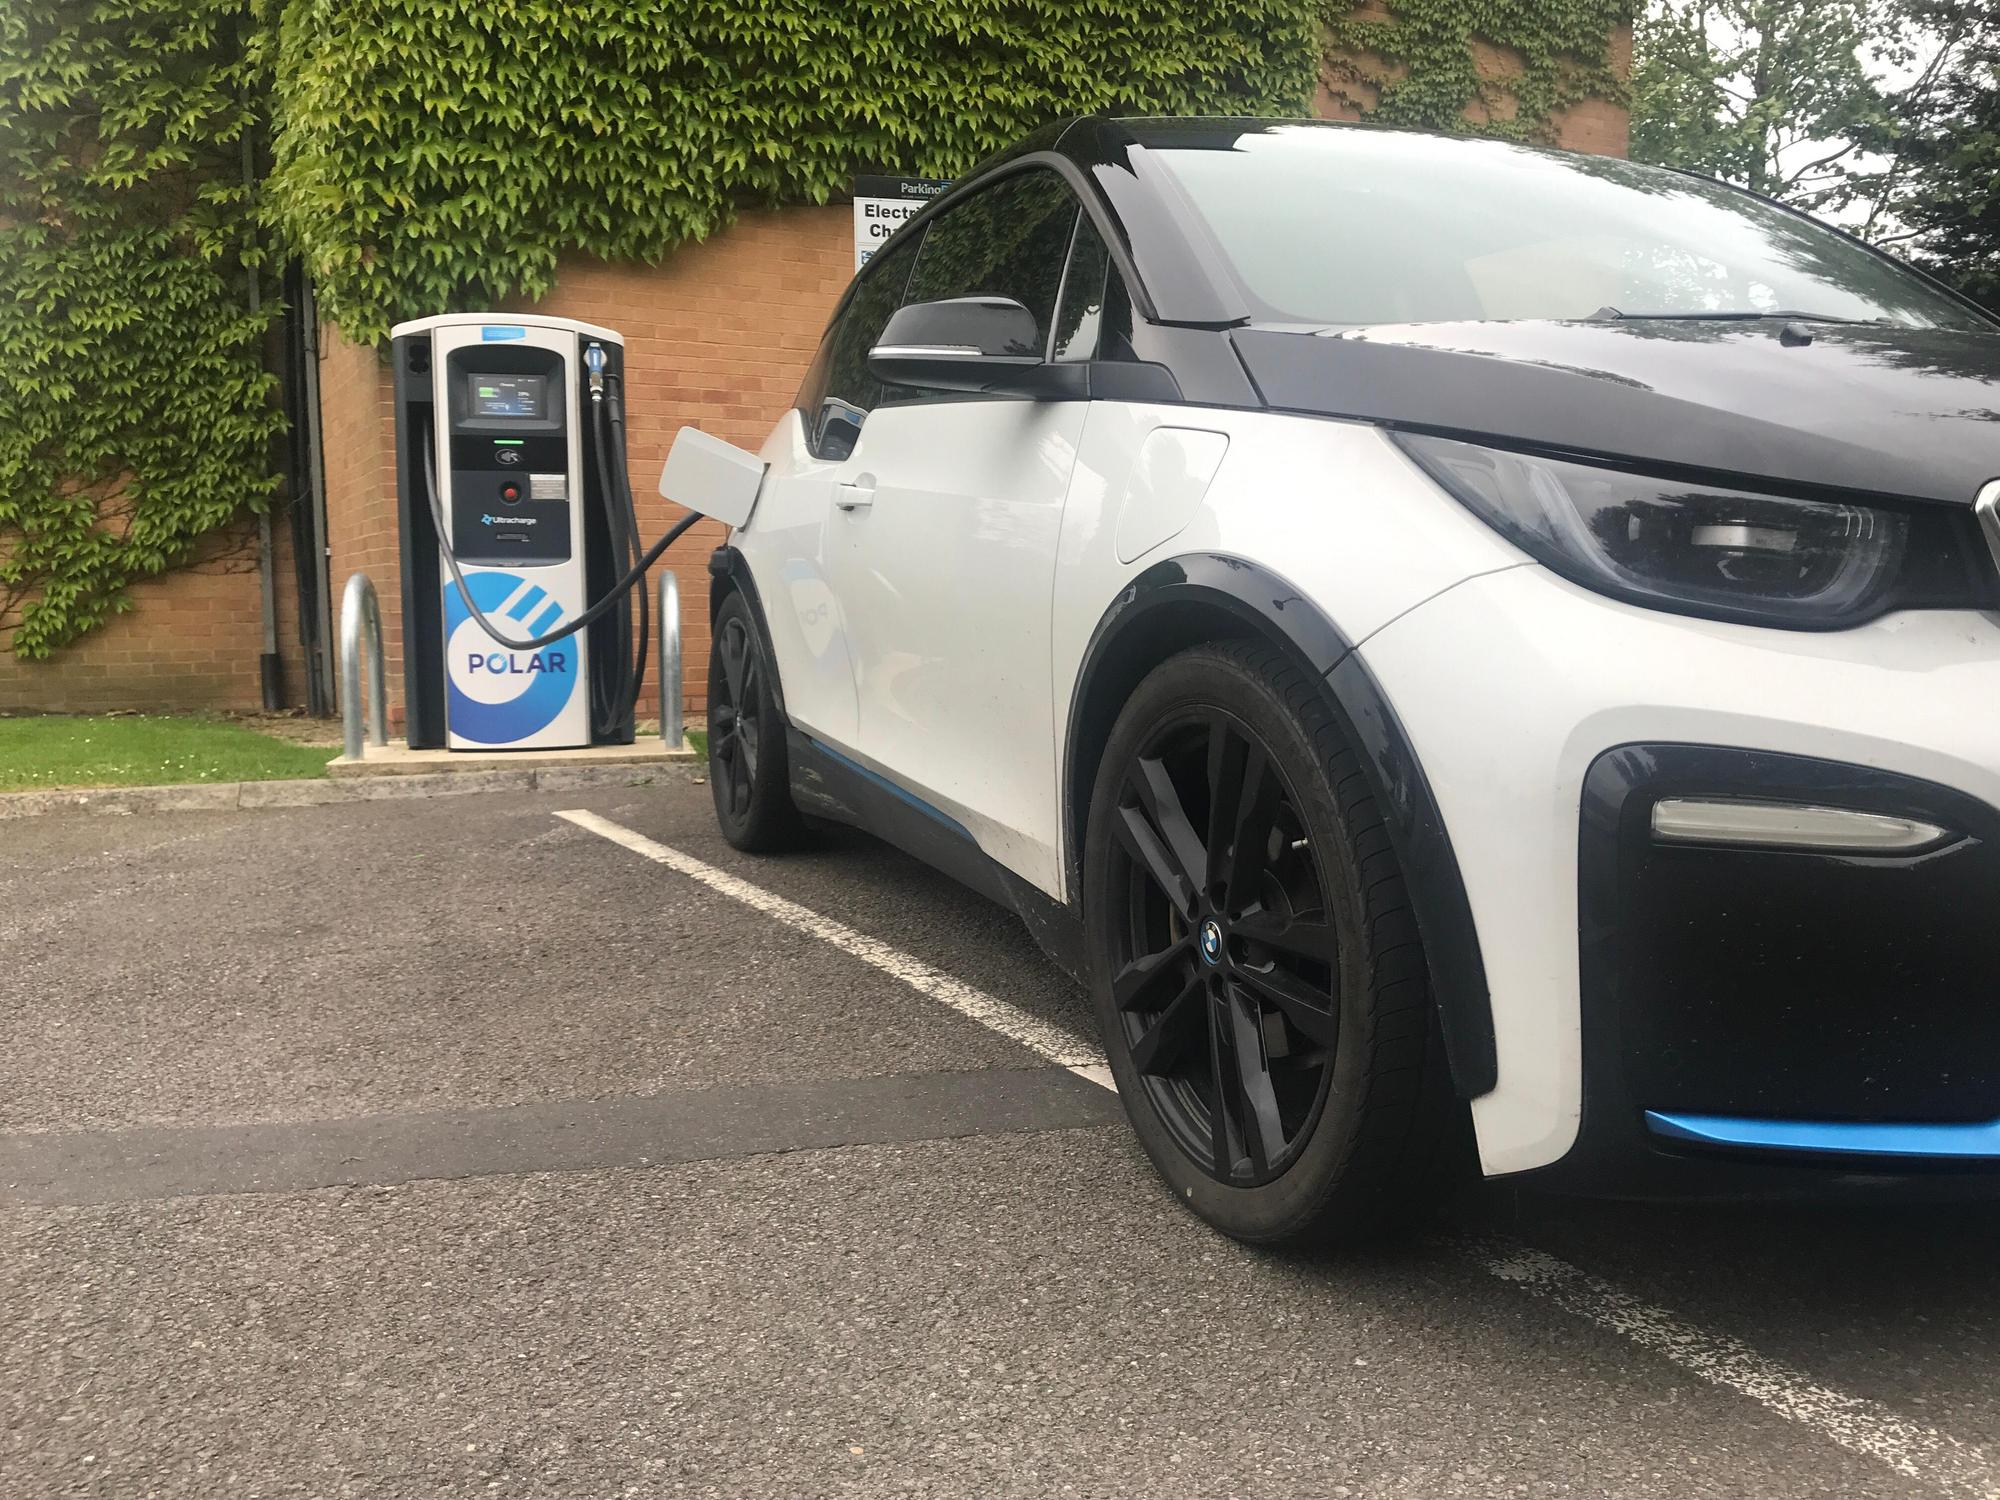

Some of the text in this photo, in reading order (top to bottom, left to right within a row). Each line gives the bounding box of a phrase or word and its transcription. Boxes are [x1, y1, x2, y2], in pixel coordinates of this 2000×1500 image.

[869, 223, 898, 238] Ch
[492, 516, 537, 526] Ultracharge
[468, 652, 567, 674] POLAR
